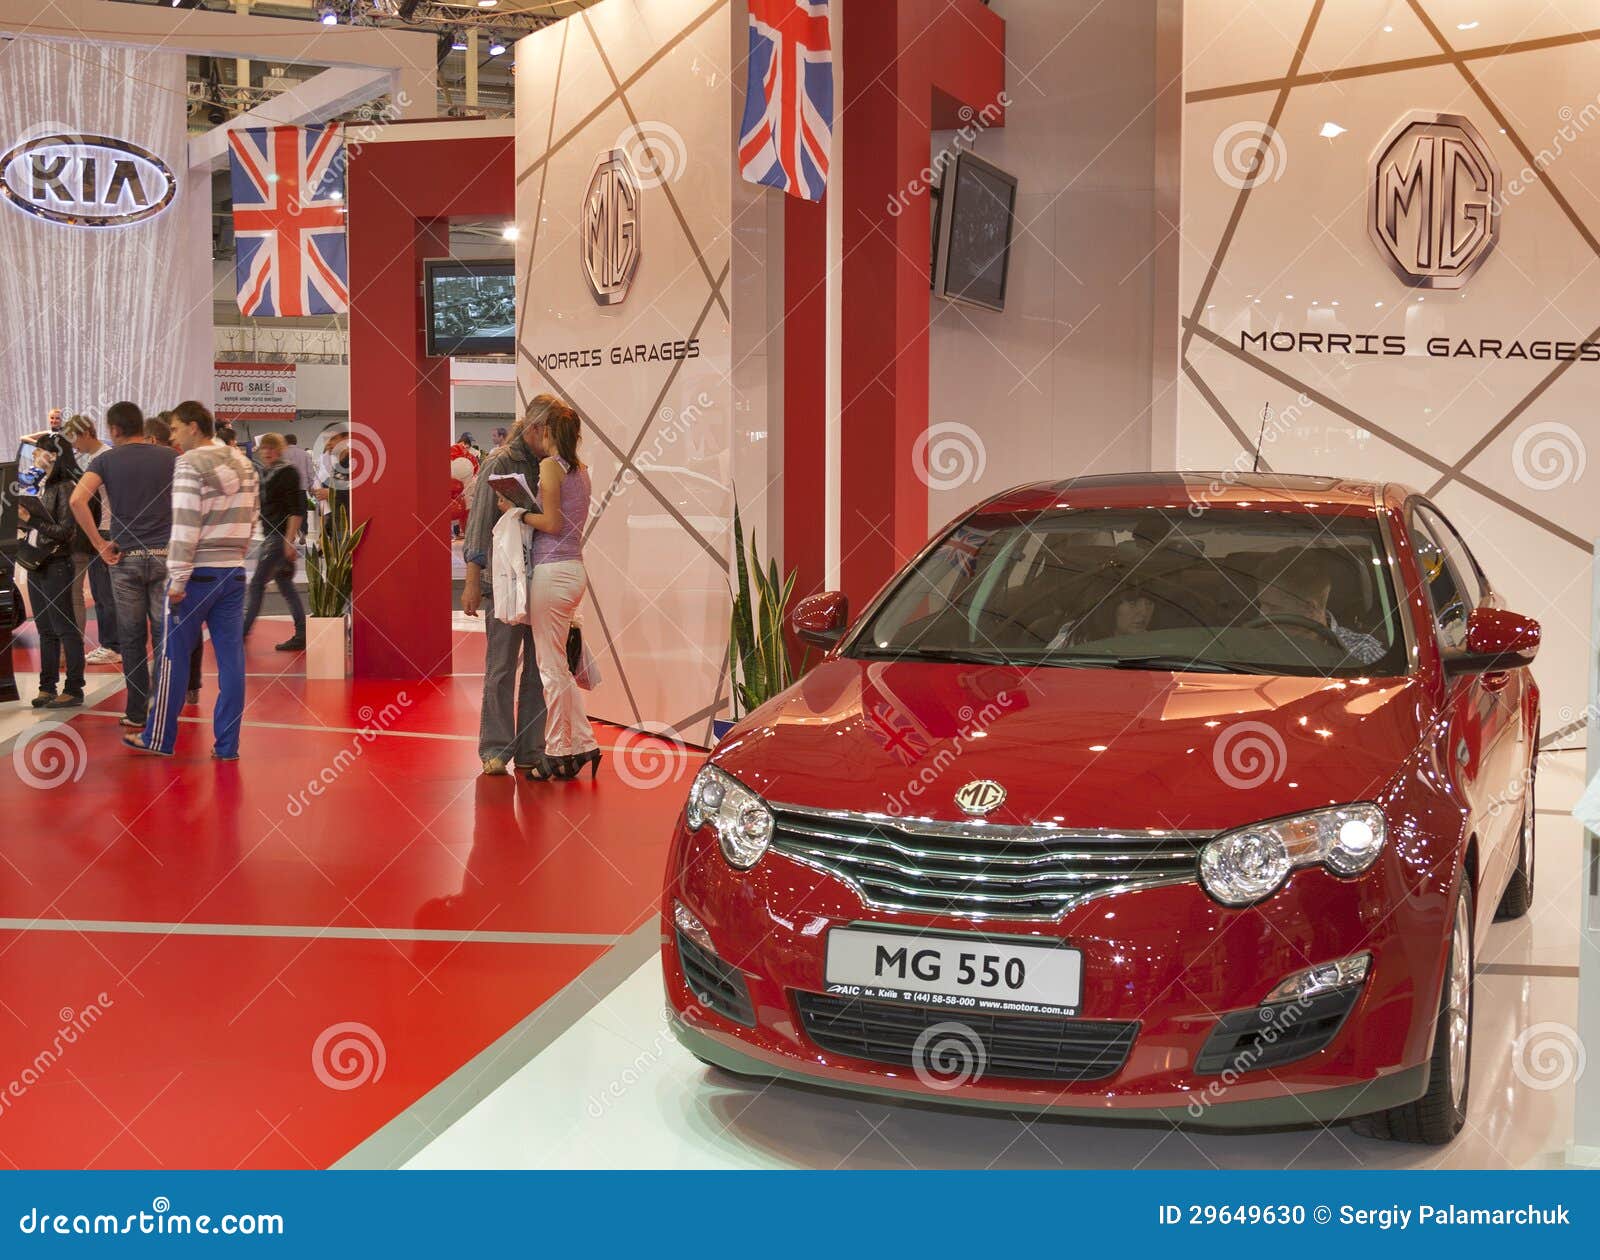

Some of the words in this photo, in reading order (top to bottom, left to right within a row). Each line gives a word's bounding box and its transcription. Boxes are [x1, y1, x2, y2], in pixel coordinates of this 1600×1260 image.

[29, 154, 149, 206] KIA
[1384, 137, 1489, 270] MG
[588, 169, 634, 287] MG
[537, 349, 602, 370] MORRIS
[611, 339, 700, 365] GARAGES
[1241, 330, 1405, 355] MORRIS
[1426, 337, 1600, 361] GARAGES
[220, 381, 244, 392] AVTO
[248, 382, 270, 392] SALE
[961, 783, 1000, 807] MG
[875, 944, 941, 982] MG
[957, 952, 1026, 990] 550
[913, 992, 930, 1003] (44)
[932, 995, 976, 1007] 58-58-000
[979, 1000, 1075, 1016] www.smotors.com.ua
